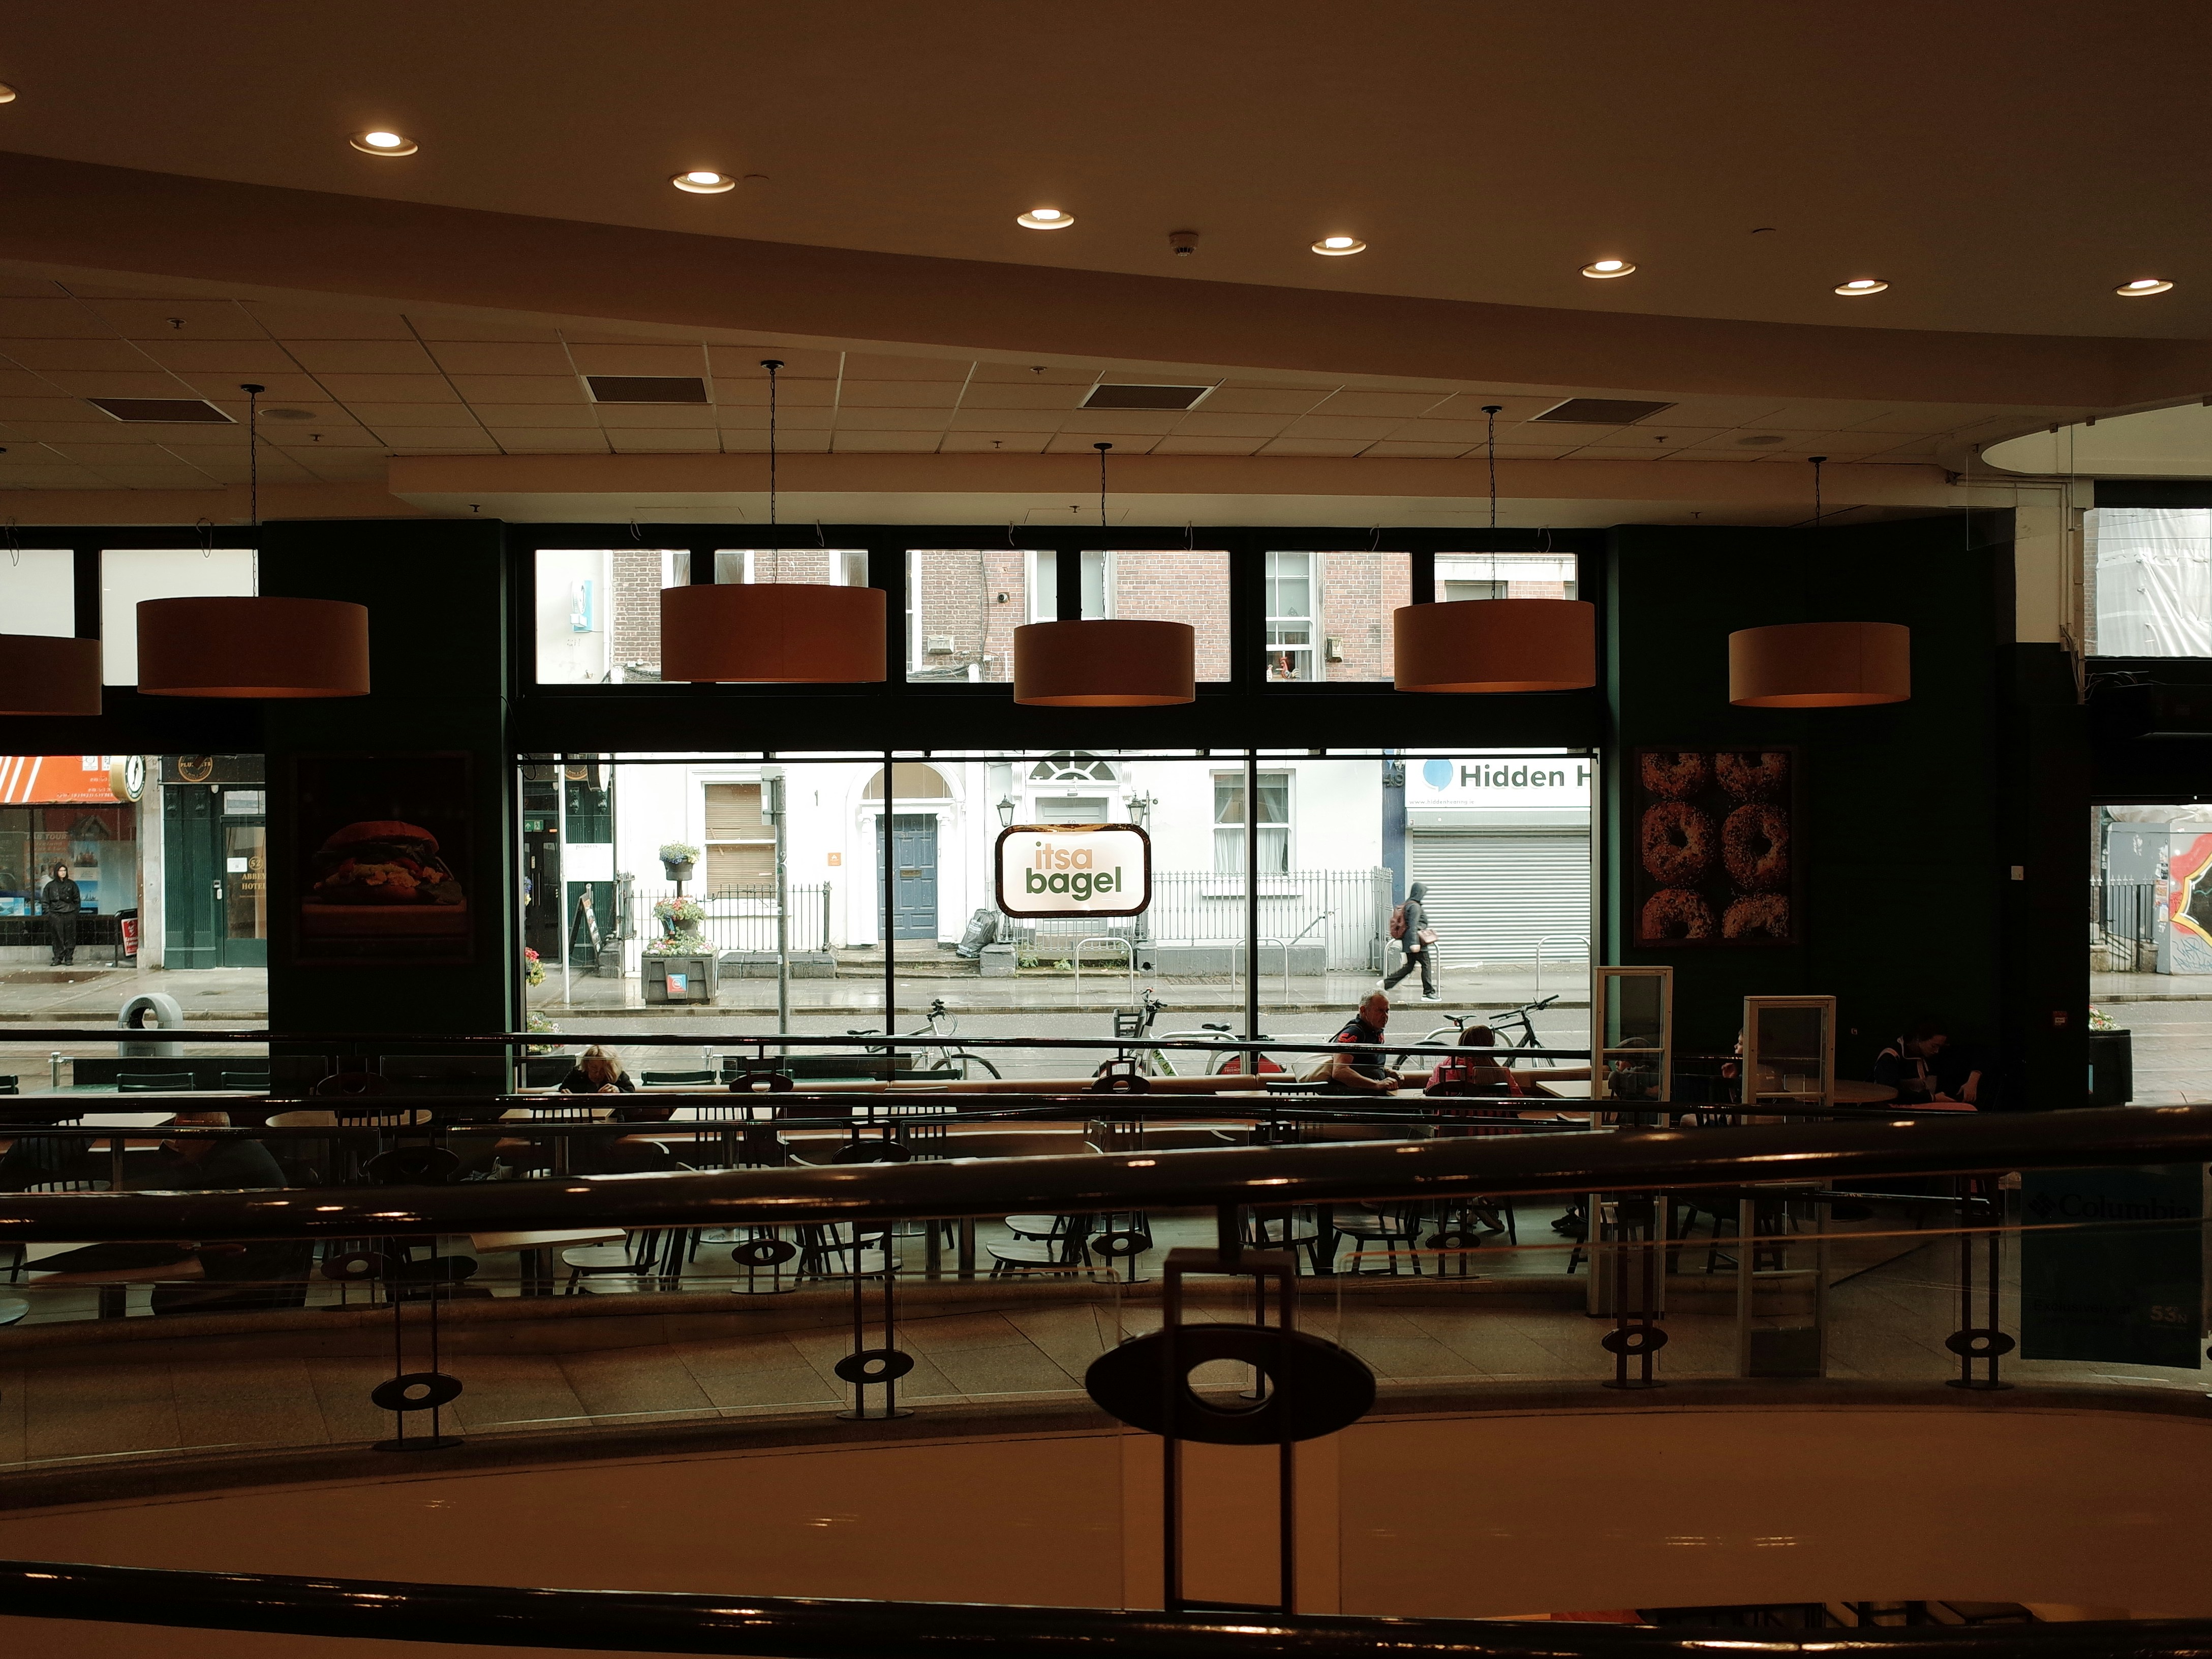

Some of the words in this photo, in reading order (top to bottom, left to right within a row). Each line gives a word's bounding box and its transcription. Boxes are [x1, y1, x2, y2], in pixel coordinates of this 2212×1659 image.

[1382, 773, 1405, 787] 49
[1461, 764, 1564, 787] Hidden
[250, 859, 261, 867] 52
[1035, 841, 1093, 870] itsa
[1026, 866, 1122, 902] bagel
[1153, 1049, 1175, 1076] MOBY
[2059, 1193, 2191, 1220] Columbia
